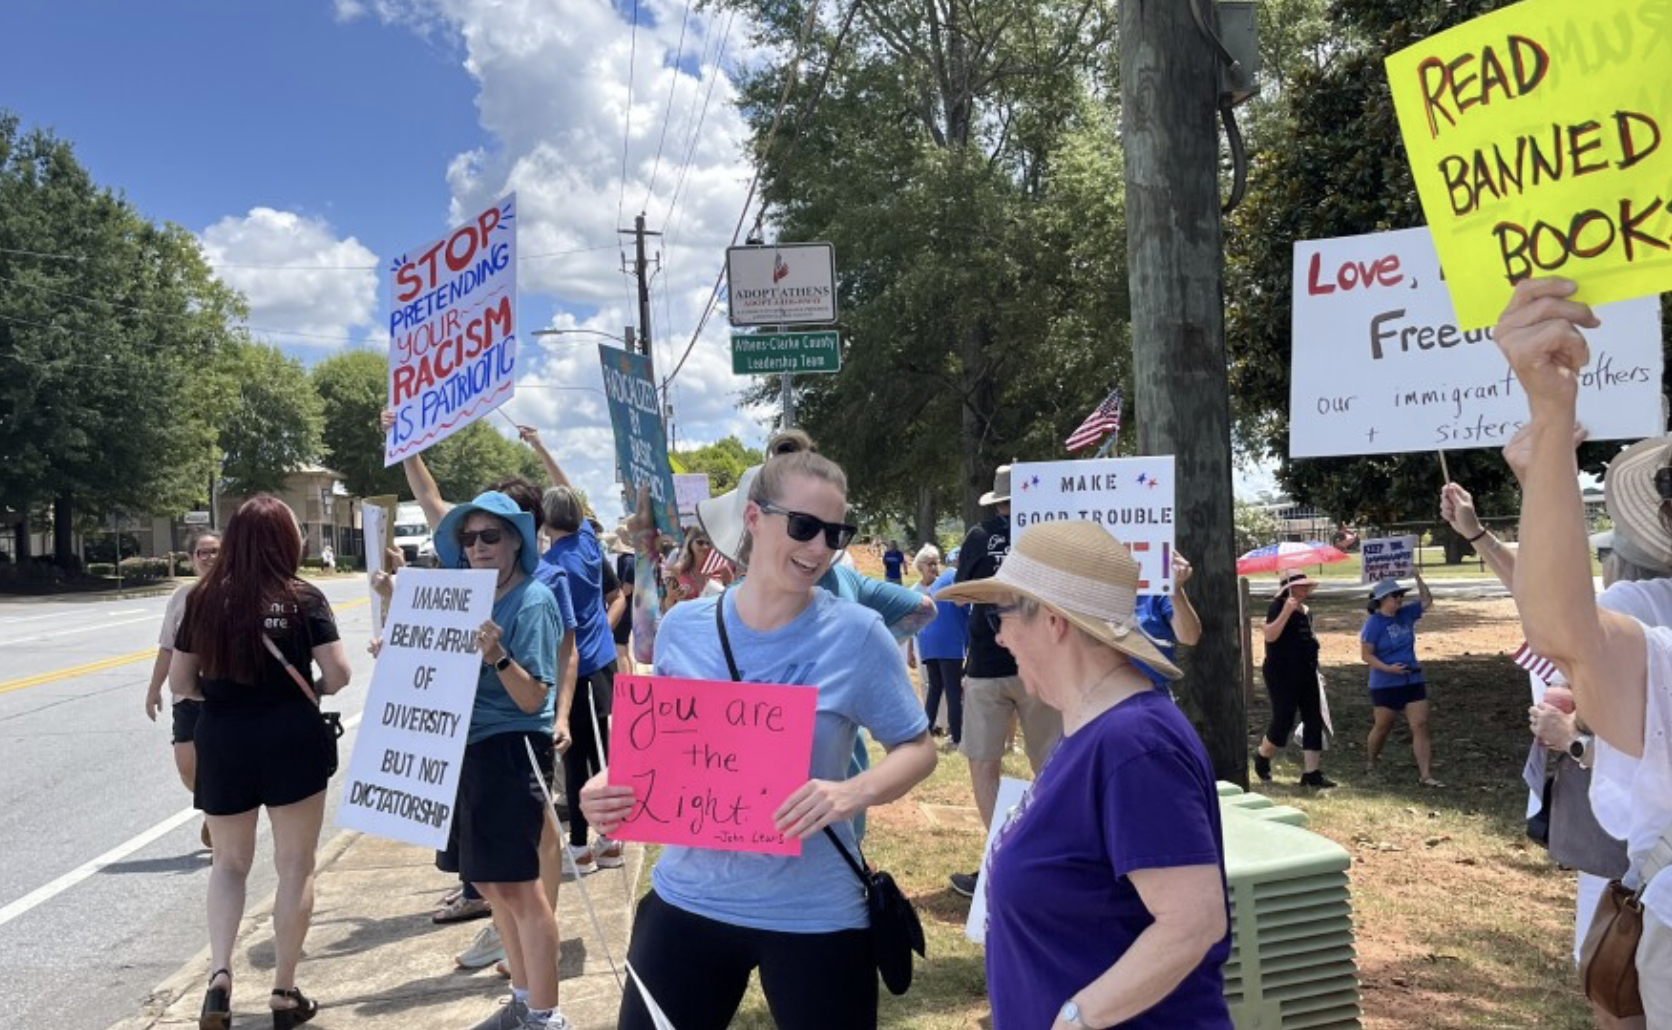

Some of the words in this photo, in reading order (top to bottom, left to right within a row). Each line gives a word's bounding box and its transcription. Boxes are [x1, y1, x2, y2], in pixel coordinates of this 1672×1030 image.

[1416, 34, 1550, 140] READ
[1438, 110, 1661, 216] BANNED
[397, 207, 500, 302] STOP
[1491, 196, 1672, 287] BOOK
[391, 243, 509, 338] PRETENDING
[736, 288, 776, 299] ADOPT
[781, 286, 830, 298] ATHENS
[1307, 252, 1418, 296] Love,
[393, 296, 511, 406] RACISM
[397, 309, 461, 364] YOUR
[735, 337, 800, 352] Athens-Clarke
[802, 335, 835, 351] County
[1370, 309, 1494, 360] Free
[747, 356, 798, 369] Leadership
[800, 354, 825, 367] Team
[392, 406, 413, 446] IS
[422, 336, 515, 429] PATRIOTIC
[1317, 394, 1360, 415] our
[1395, 366, 1516, 418] immigrant
[1577, 351, 1650, 391] others
[1436, 414, 1523, 443] sisters
[1061, 473, 1117, 493] MAKE
[1078, 507, 1173, 525] TROUBLE
[412, 585, 472, 612] IMAGINE
[390, 624, 433, 650] BEING
[434, 627, 479, 654] AFRAID
[414, 665, 436, 690] OF
[382, 702, 461, 738] DIVERSITY
[726, 699, 785, 732] are
[381, 748, 416, 778] BUT
[418, 757, 449, 785] NOT
[682, 743, 739, 772] the
[350, 781, 450, 829] DICTATORSHIP
